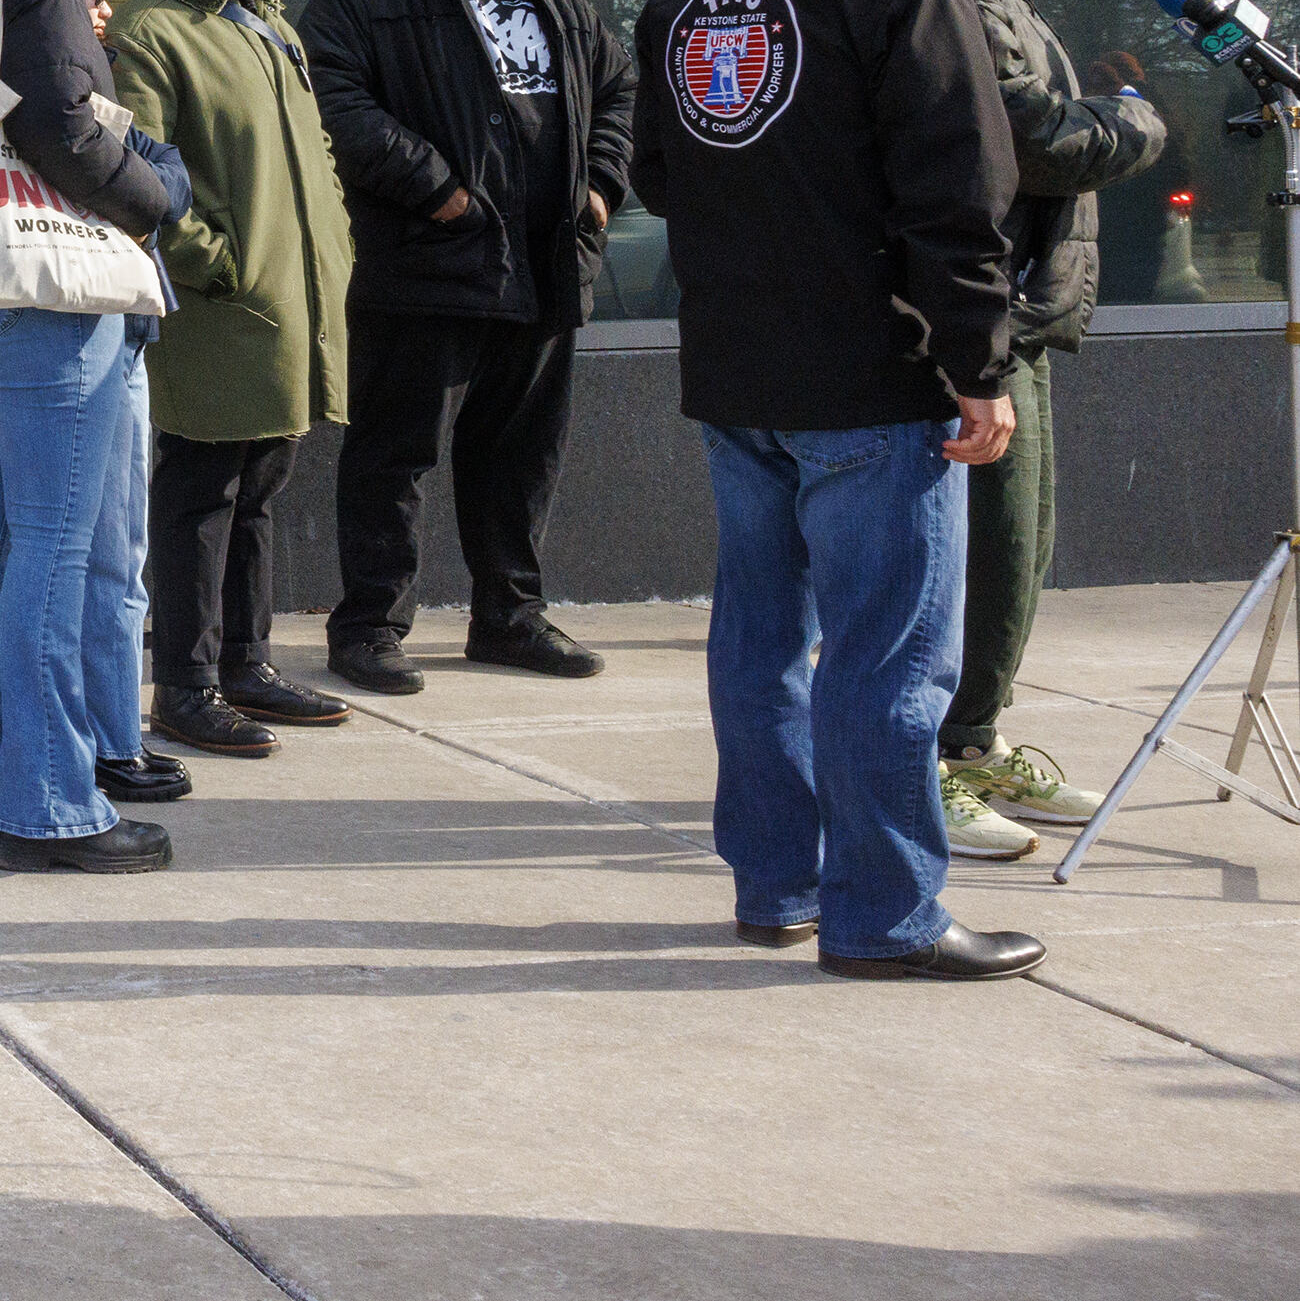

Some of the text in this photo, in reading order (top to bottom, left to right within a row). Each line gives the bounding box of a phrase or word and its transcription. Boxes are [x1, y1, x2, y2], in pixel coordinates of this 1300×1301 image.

[694, 13, 767, 26] KEYSTONE STATE
[711, 34, 744, 48] UFCW
[674, 43, 784, 134] UNITED FOOD & COMMERCIAL WORKERS
[15, 219, 109, 241] WORKERS
